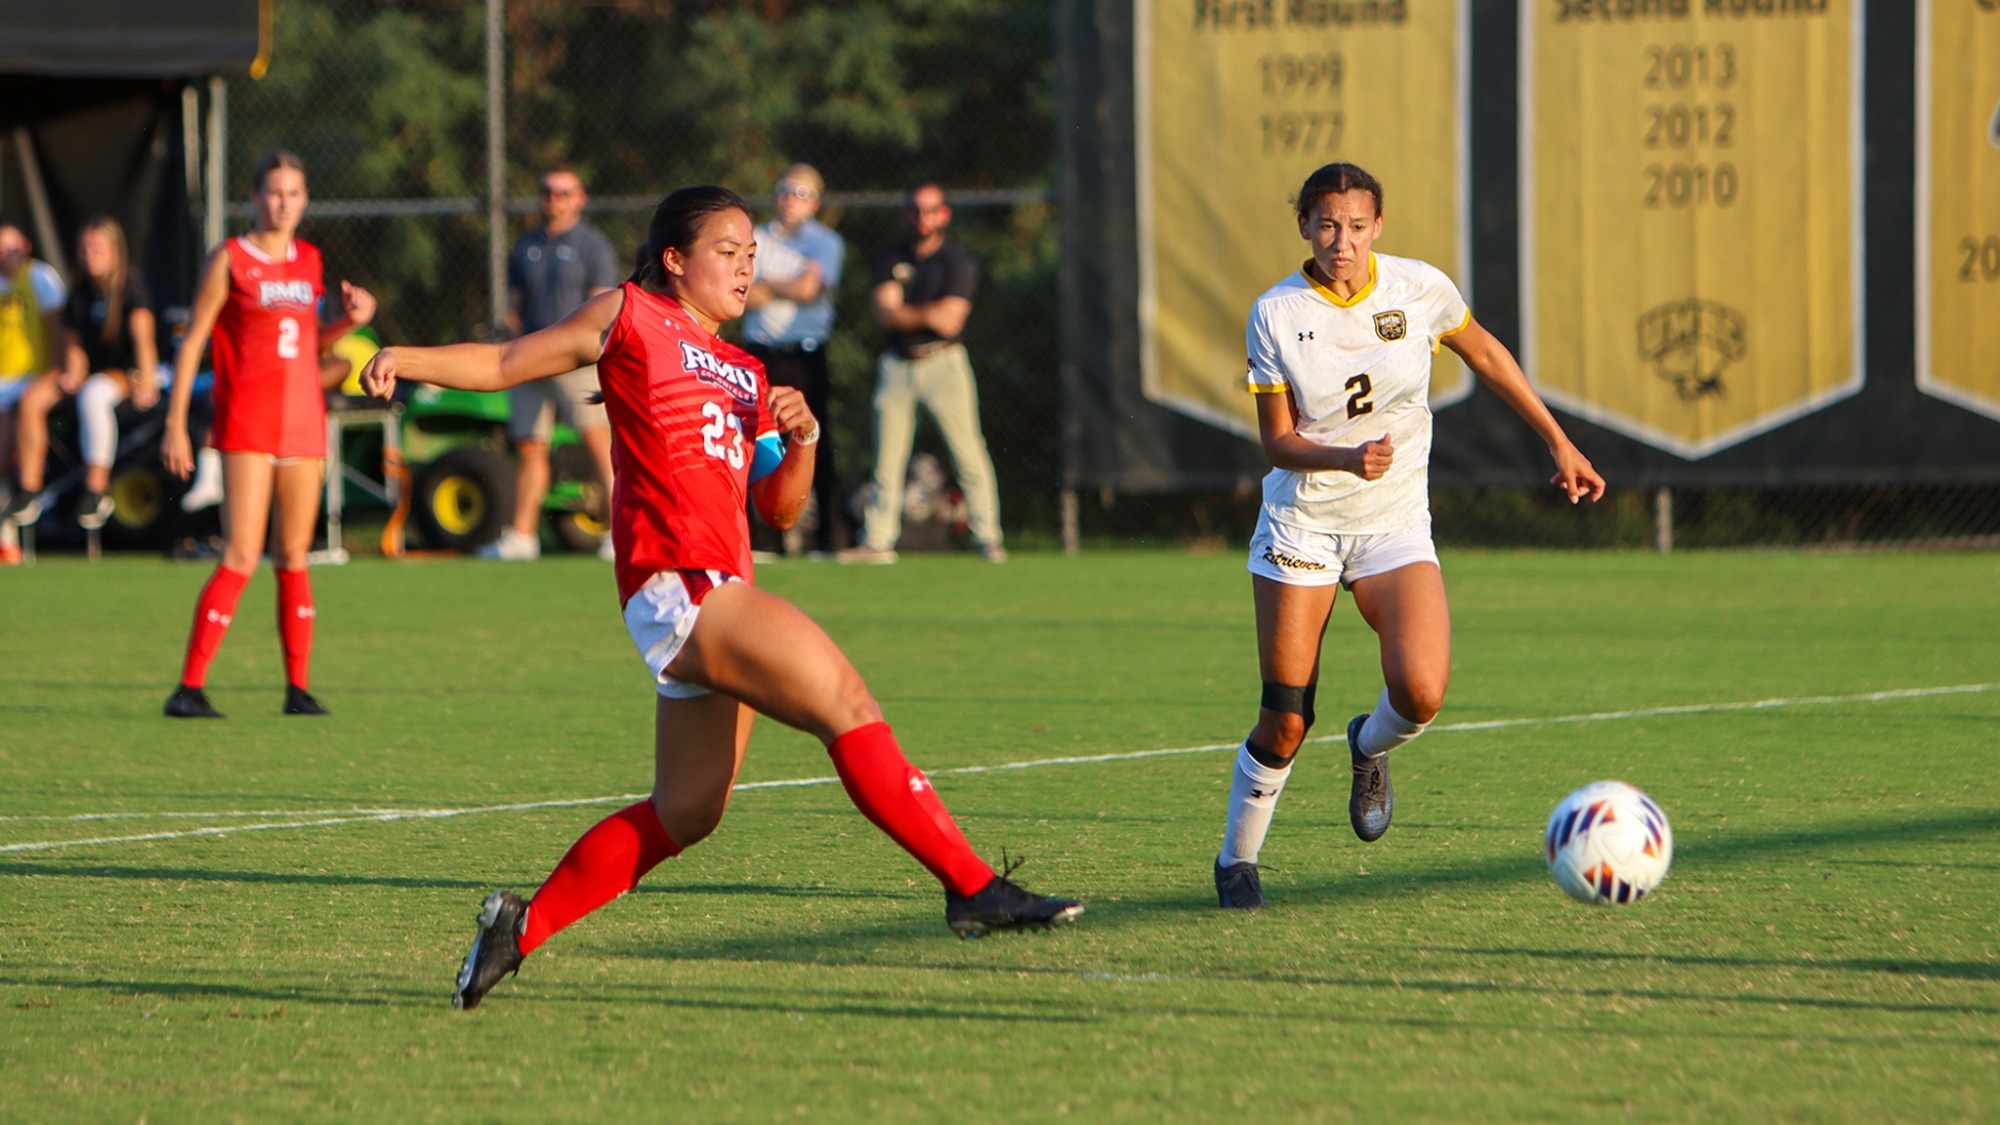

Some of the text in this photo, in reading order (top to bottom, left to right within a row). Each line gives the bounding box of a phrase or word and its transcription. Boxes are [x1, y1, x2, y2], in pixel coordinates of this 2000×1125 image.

[1260, 53, 1344, 95] 1999
[1643, 43, 1737, 90] 2013
[1260, 111, 1344, 153] 1977
[1643, 103, 1736, 149] 2012
[1643, 163, 1738, 209] 2010
[277, 317, 299, 359] 2
[680, 341, 758, 396] RMU
[700, 369, 750, 401] COLONIALS
[1345, 373, 1374, 420] 2
[701, 401, 744, 471] 23
[1262, 546, 1326, 571] Retrievers
